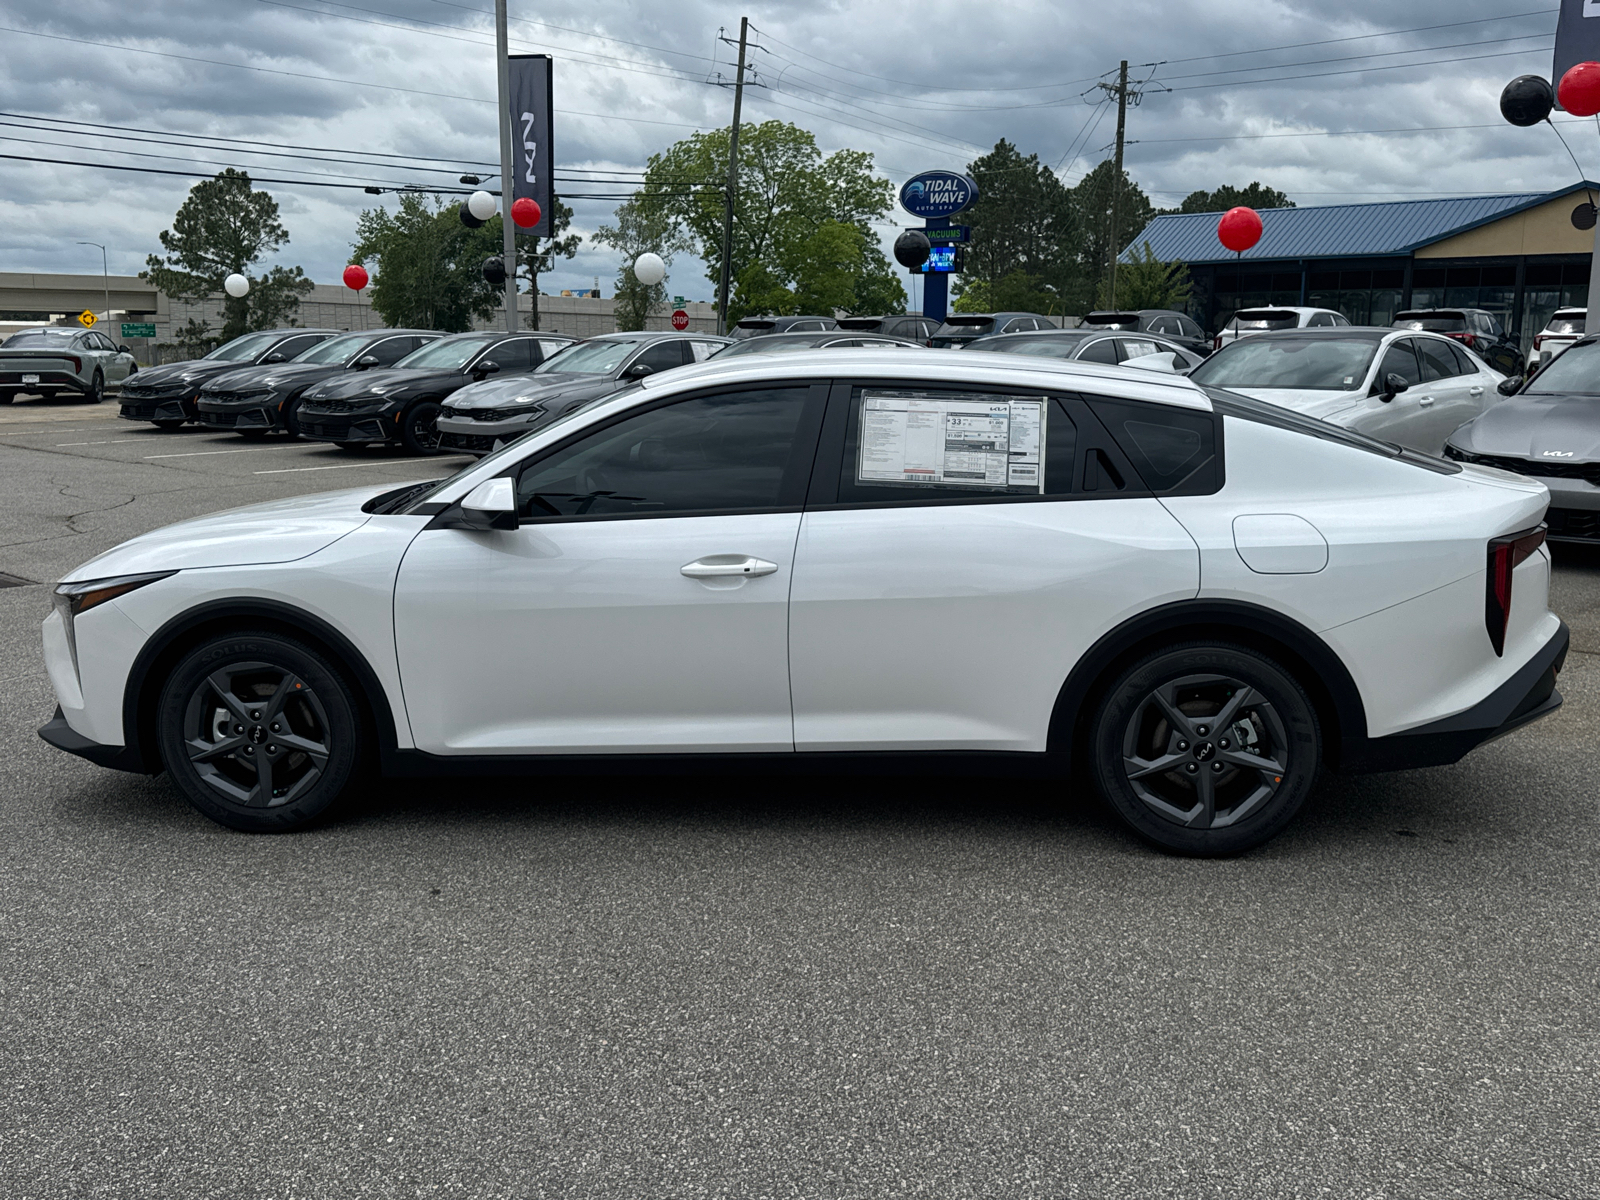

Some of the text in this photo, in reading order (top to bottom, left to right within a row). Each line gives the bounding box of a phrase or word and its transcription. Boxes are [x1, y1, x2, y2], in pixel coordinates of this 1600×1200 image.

[925, 179, 958, 192] TIDAL
[930, 191, 965, 204] WAVE
[927, 229, 961, 239] VACUUMS
[672, 316, 689, 325] STOP
[951, 417, 962, 426] 33
[1543, 450, 1574, 458] KIA
[202, 644, 257, 664] SOLUS
[1183, 655, 1248, 671] SOLUS
